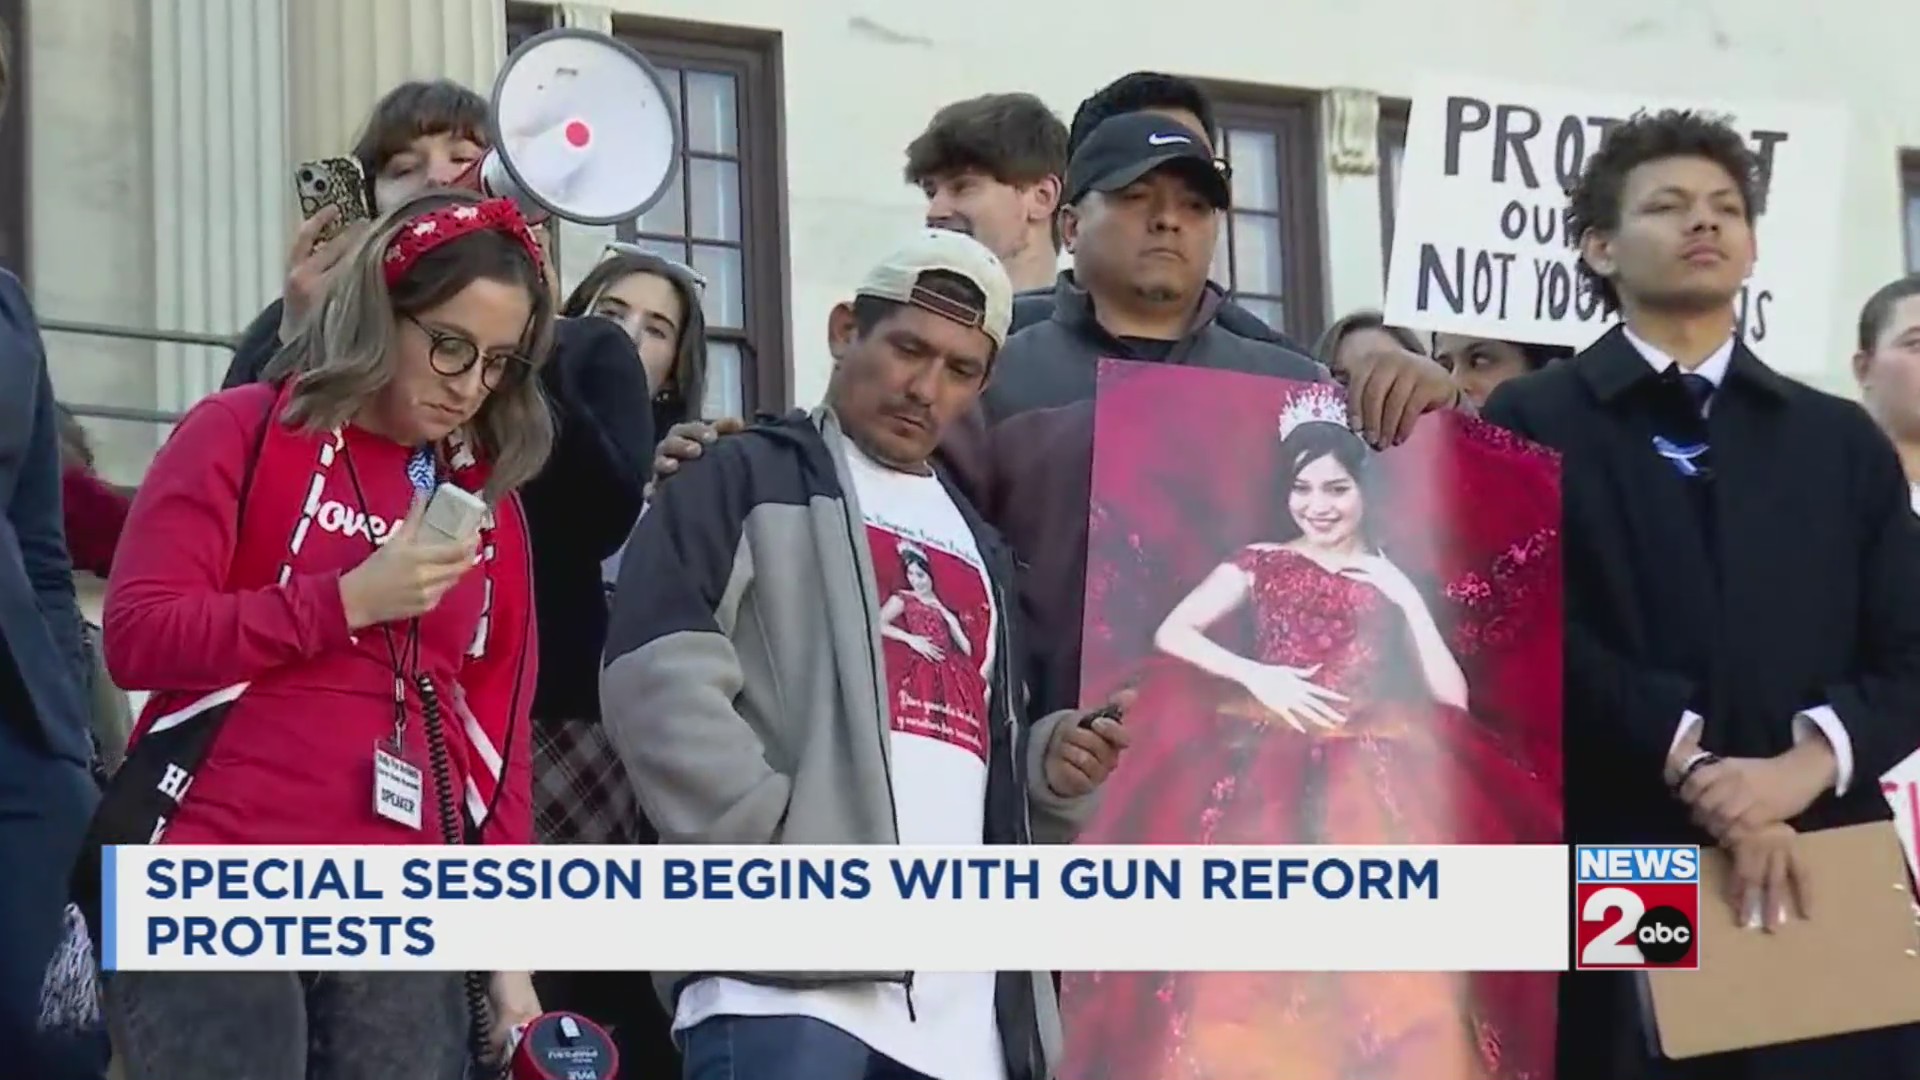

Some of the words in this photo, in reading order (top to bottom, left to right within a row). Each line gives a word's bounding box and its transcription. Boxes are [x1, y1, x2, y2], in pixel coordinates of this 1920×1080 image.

[1444, 96, 1788, 216] PROTT
[1417, 243, 1516, 321] NOT
[1534, 257, 1612, 323] YOU
[381, 787, 416, 814] SPEAKER
